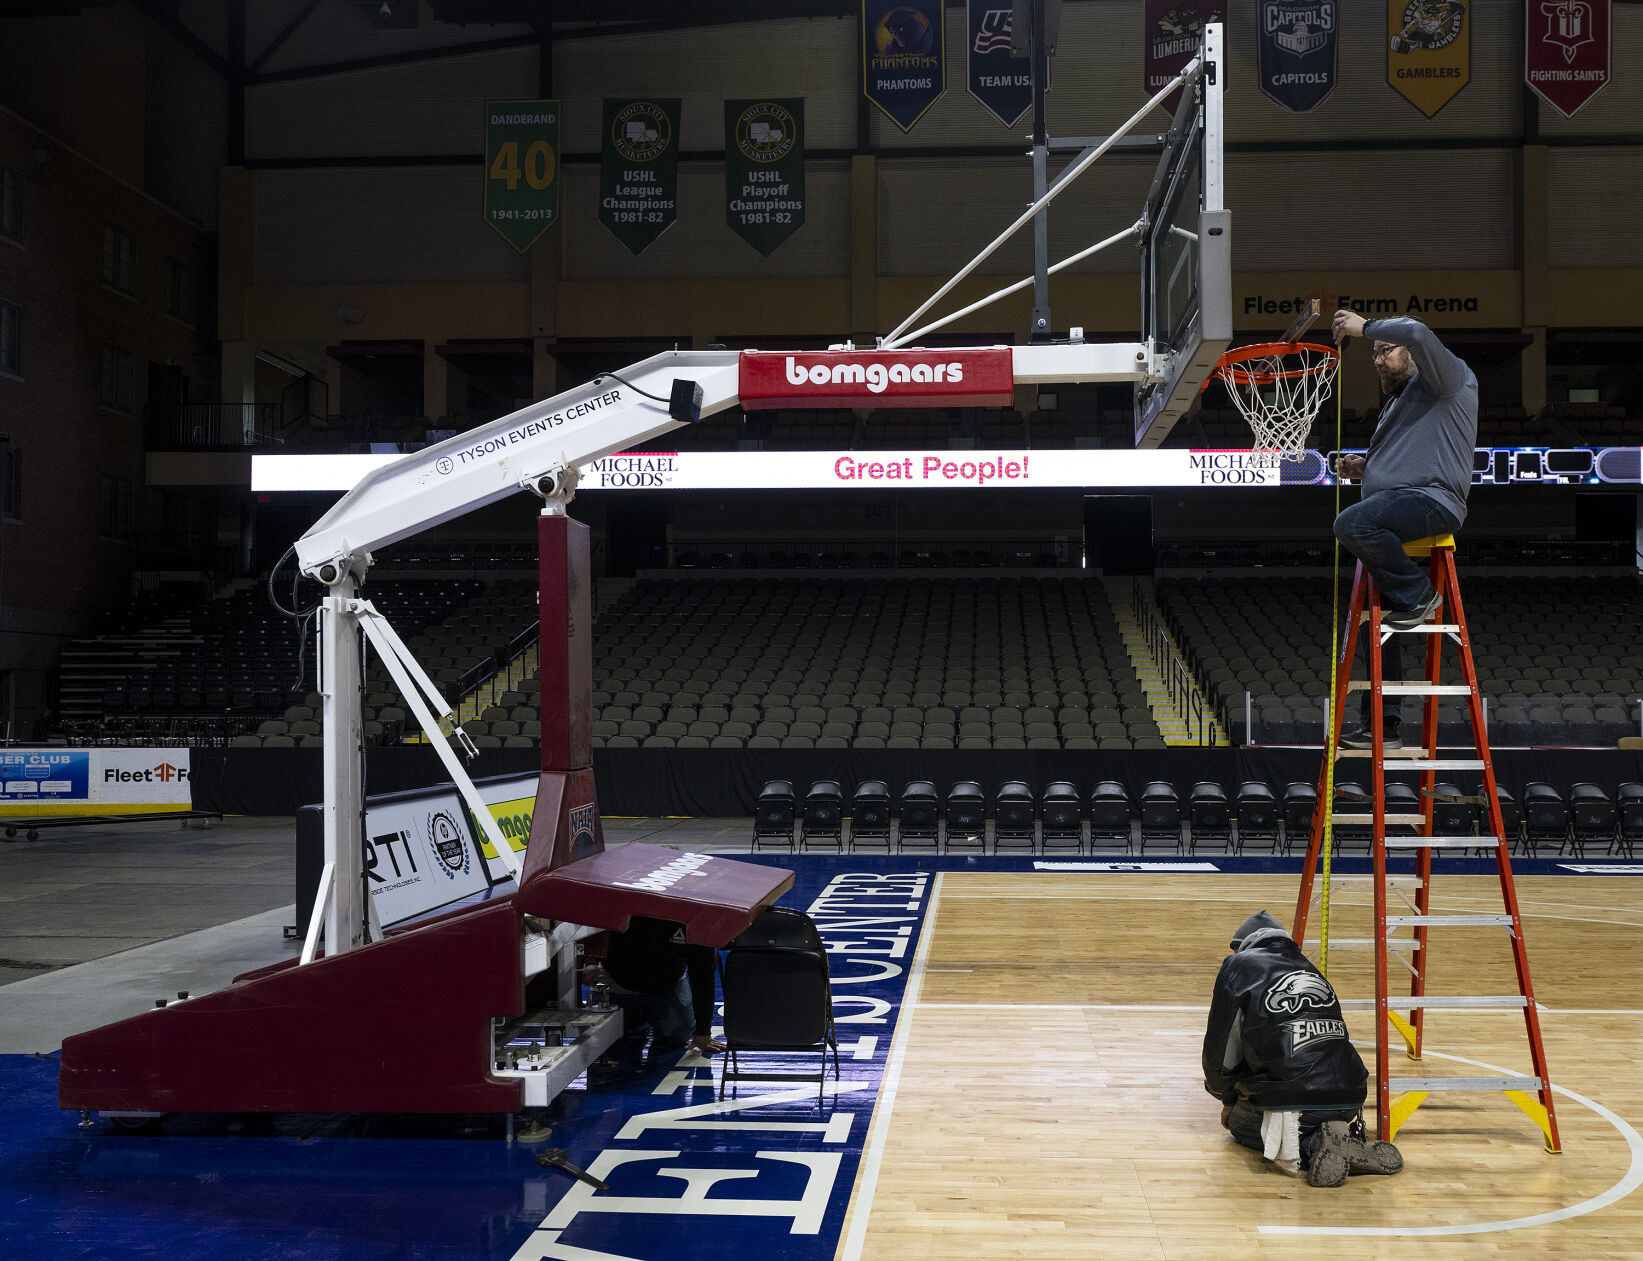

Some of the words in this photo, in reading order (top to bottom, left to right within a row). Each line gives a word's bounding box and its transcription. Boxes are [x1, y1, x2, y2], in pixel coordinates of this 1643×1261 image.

[1267, 4, 1331, 31] CAPITOLS
[872, 56, 938, 70] PHANTOMS
[1272, 73, 1327, 86] CAPITOLS
[1397, 68, 1461, 79] GAMBLERS
[1530, 70, 1572, 81] FIGHTING
[1574, 70, 1605, 81] SAINTS
[877, 78, 932, 90] PHANTOMS
[979, 76, 1012, 87] TEAM
[1014, 75, 1032, 86] US
[491, 114, 556, 125] DANDERAND
[489, 140, 556, 191] 40
[623, 171, 657, 181] USHL
[749, 171, 782, 182] USHL
[616, 184, 663, 197] League
[742, 184, 790, 198] Playoff
[603, 198, 674, 211] Champions
[729, 198, 802, 211] Champions
[491, 210, 552, 220] 1941-2013
[612, 211, 664, 223] 1981-82
[739, 212, 792, 224] 1981-82
[1244, 296, 1304, 314] Fleet
[1337, 296, 1397, 313] Farm
[1405, 295, 1479, 312] Arena
[785, 357, 963, 393] bomgaars
[457, 436, 507, 464] TYSON
[508, 413, 564, 446] EVENTS
[566, 390, 621, 420] CENTER
[590, 458, 679, 472] MICHAEL
[1190, 454, 1280, 469] MICHAEL
[834, 456, 913, 480] Great
[923, 456, 1029, 484] People!
[1201, 469, 1266, 484] FOODS
[601, 473, 664, 487] FOODS
[30, 756, 71, 764] CLUB
[104, 769, 153, 782] Fleet
[1291, 1018, 1345, 1049] EAGLES
